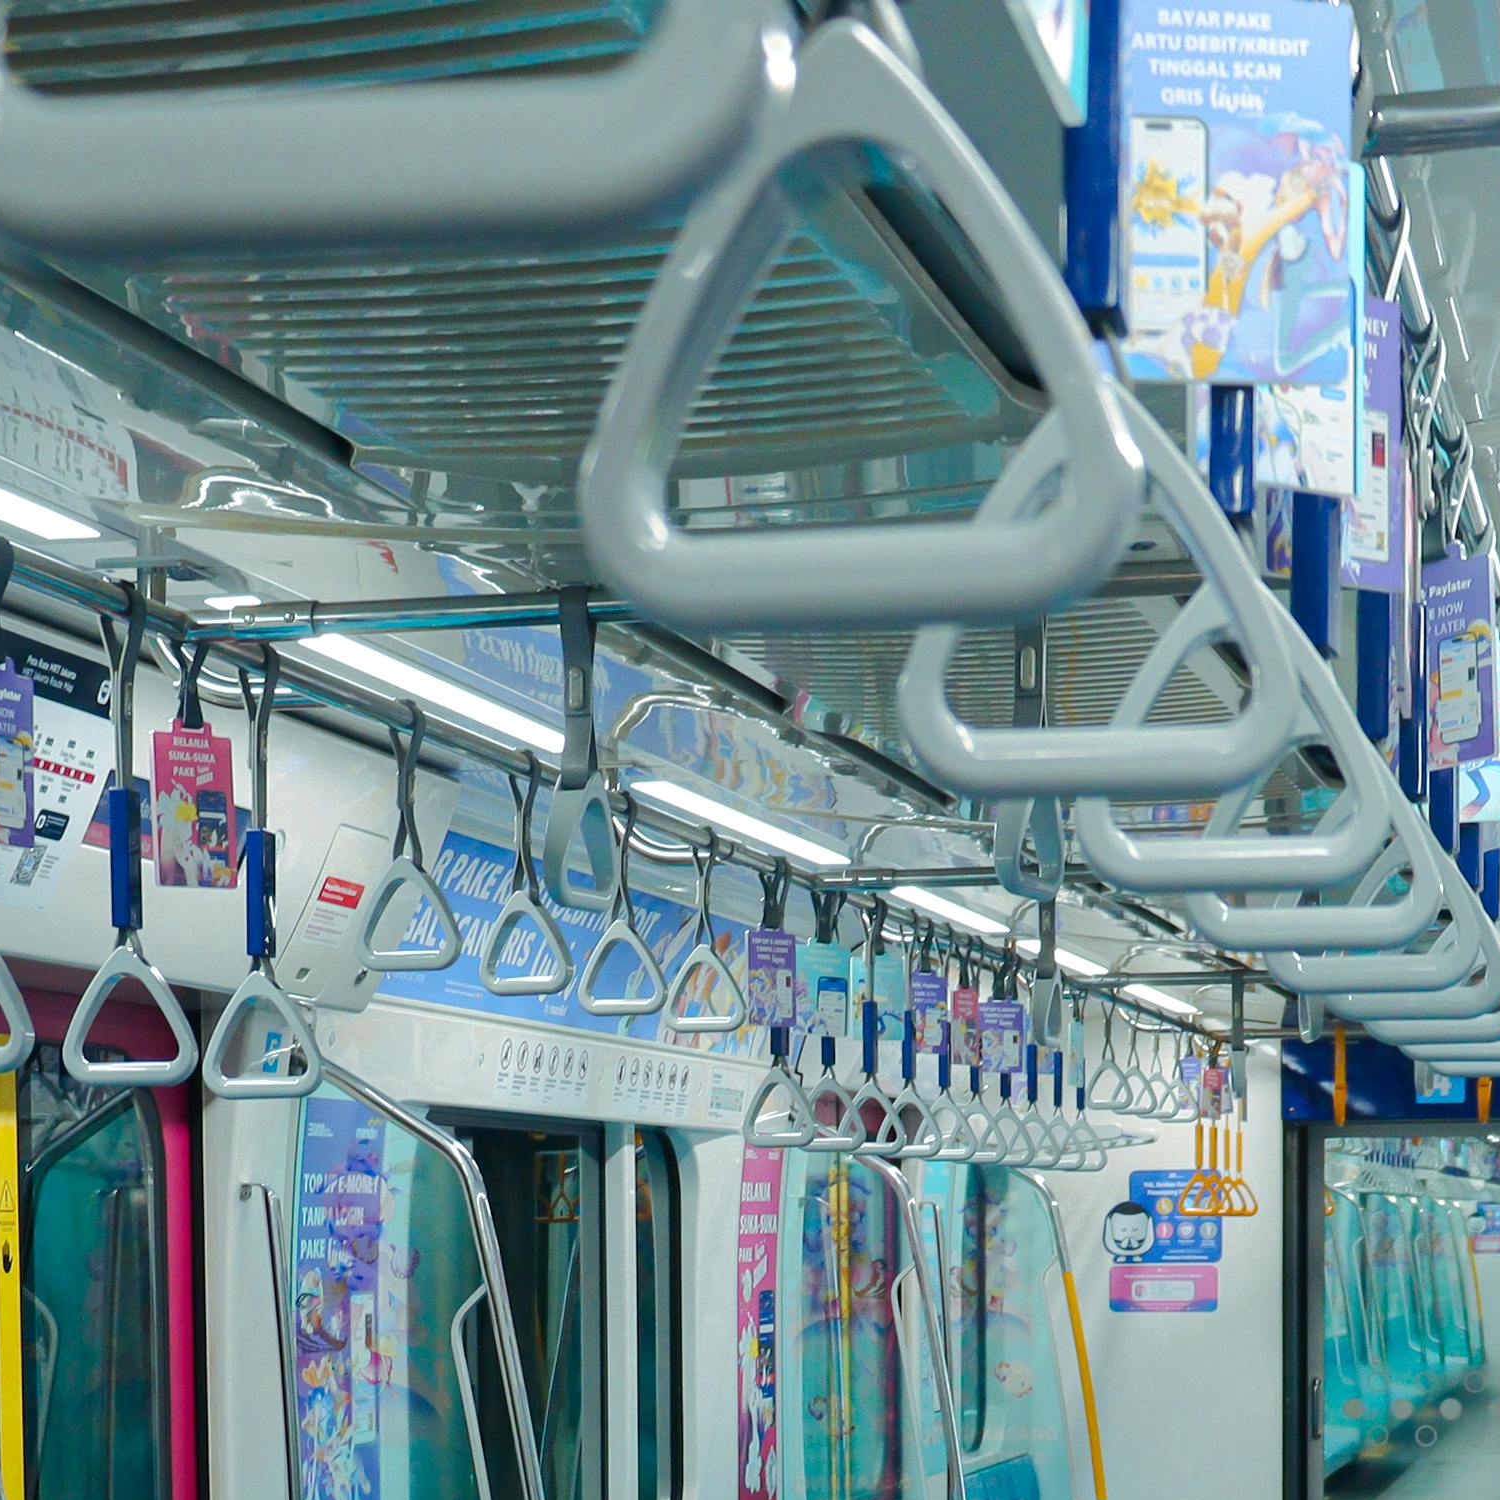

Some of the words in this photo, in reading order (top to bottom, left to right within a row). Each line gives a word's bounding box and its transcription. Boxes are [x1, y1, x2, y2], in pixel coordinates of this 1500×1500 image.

[1157, 8, 1217, 29] BAYAR
[1222, 11, 1272, 32] PAKE
[1183, 34, 1309, 57] DEBIT/KREDIT
[1149, 57, 1229, 78] TINGGAL
[1233, 60, 1282, 80] SCAN
[1160, 87, 1202, 108] QRIS
[1429, 577, 1473, 598] Paylater
[1437, 600, 1465, 619] NOW
[1434, 617, 1467, 637] LATER
[173, 736, 210, 749] BELANJA
[168, 750, 216, 765] SUKA-SUKA
[172, 765, 195, 778] PAKE
[444, 852, 506, 902] PAKE
[304, 1173, 323, 1193] TOP
[338, 1174, 380, 1195] E-MONEY
[741, 1181, 772, 1202] BELANJA
[302, 1205, 335, 1226] TANPA
[740, 1213, 778, 1235] SUKA-SUKA
[300, 1237, 326, 1260] PAKE
[738, 1246, 753, 1263] PAKE
